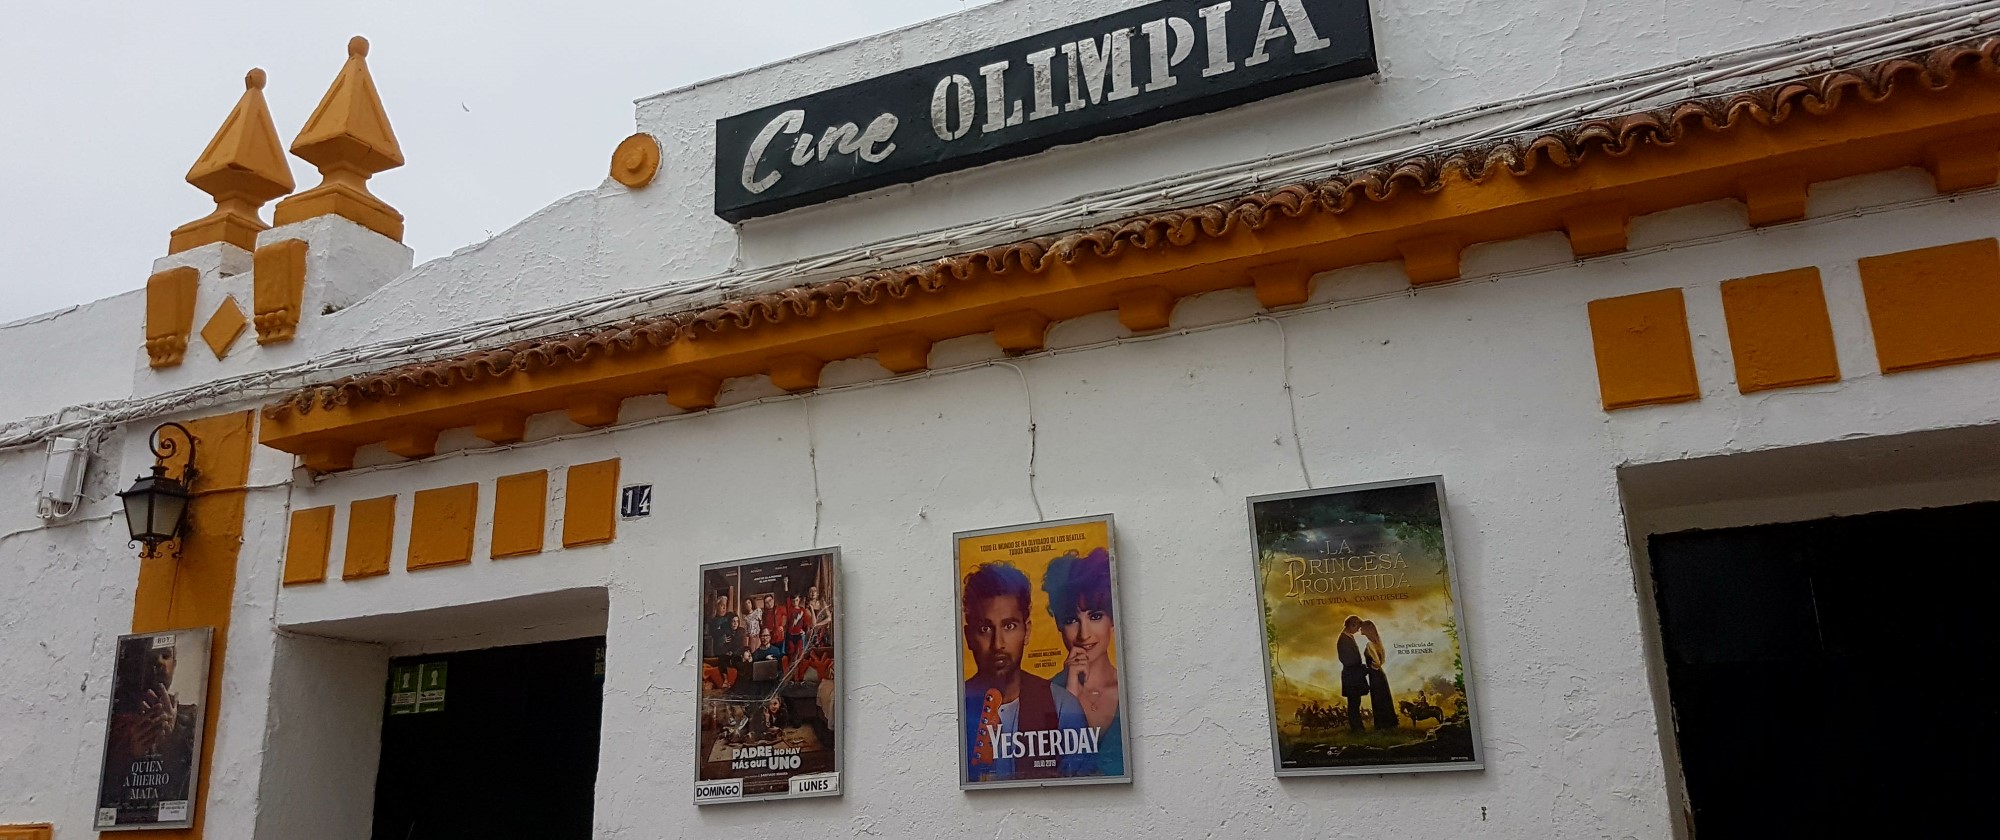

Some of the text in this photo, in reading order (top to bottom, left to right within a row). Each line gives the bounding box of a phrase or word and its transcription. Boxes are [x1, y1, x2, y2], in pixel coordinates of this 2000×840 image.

[742, 0, 1332, 195] Cine OLIMPIA
[625, 485, 651, 514] 14
[998, 542, 1014, 550] MUNDO
[1028, 537, 1050, 546] OLVIDADO
[1050, 536, 1057, 544] DE
[1056, 535, 1066, 543] LOS
[1325, 539, 1352, 556] LA
[1009, 547, 1024, 556] TODOS
[1024, 546, 1040, 554] MENOS
[1354, 594, 1378, 603] COMO
[986, 724, 1101, 759] YESTERDAY
[732, 746, 801, 760] PADRE NO HAY
[131, 760, 164, 776] QUIEN
[732, 755, 801, 770] MÁS QUE UNO
[122, 772, 169, 787] A HIERRO
[130, 787, 159, 800] MATA
[696, 785, 740, 797] DOMINGO
[799, 779, 829, 792] LUNES
